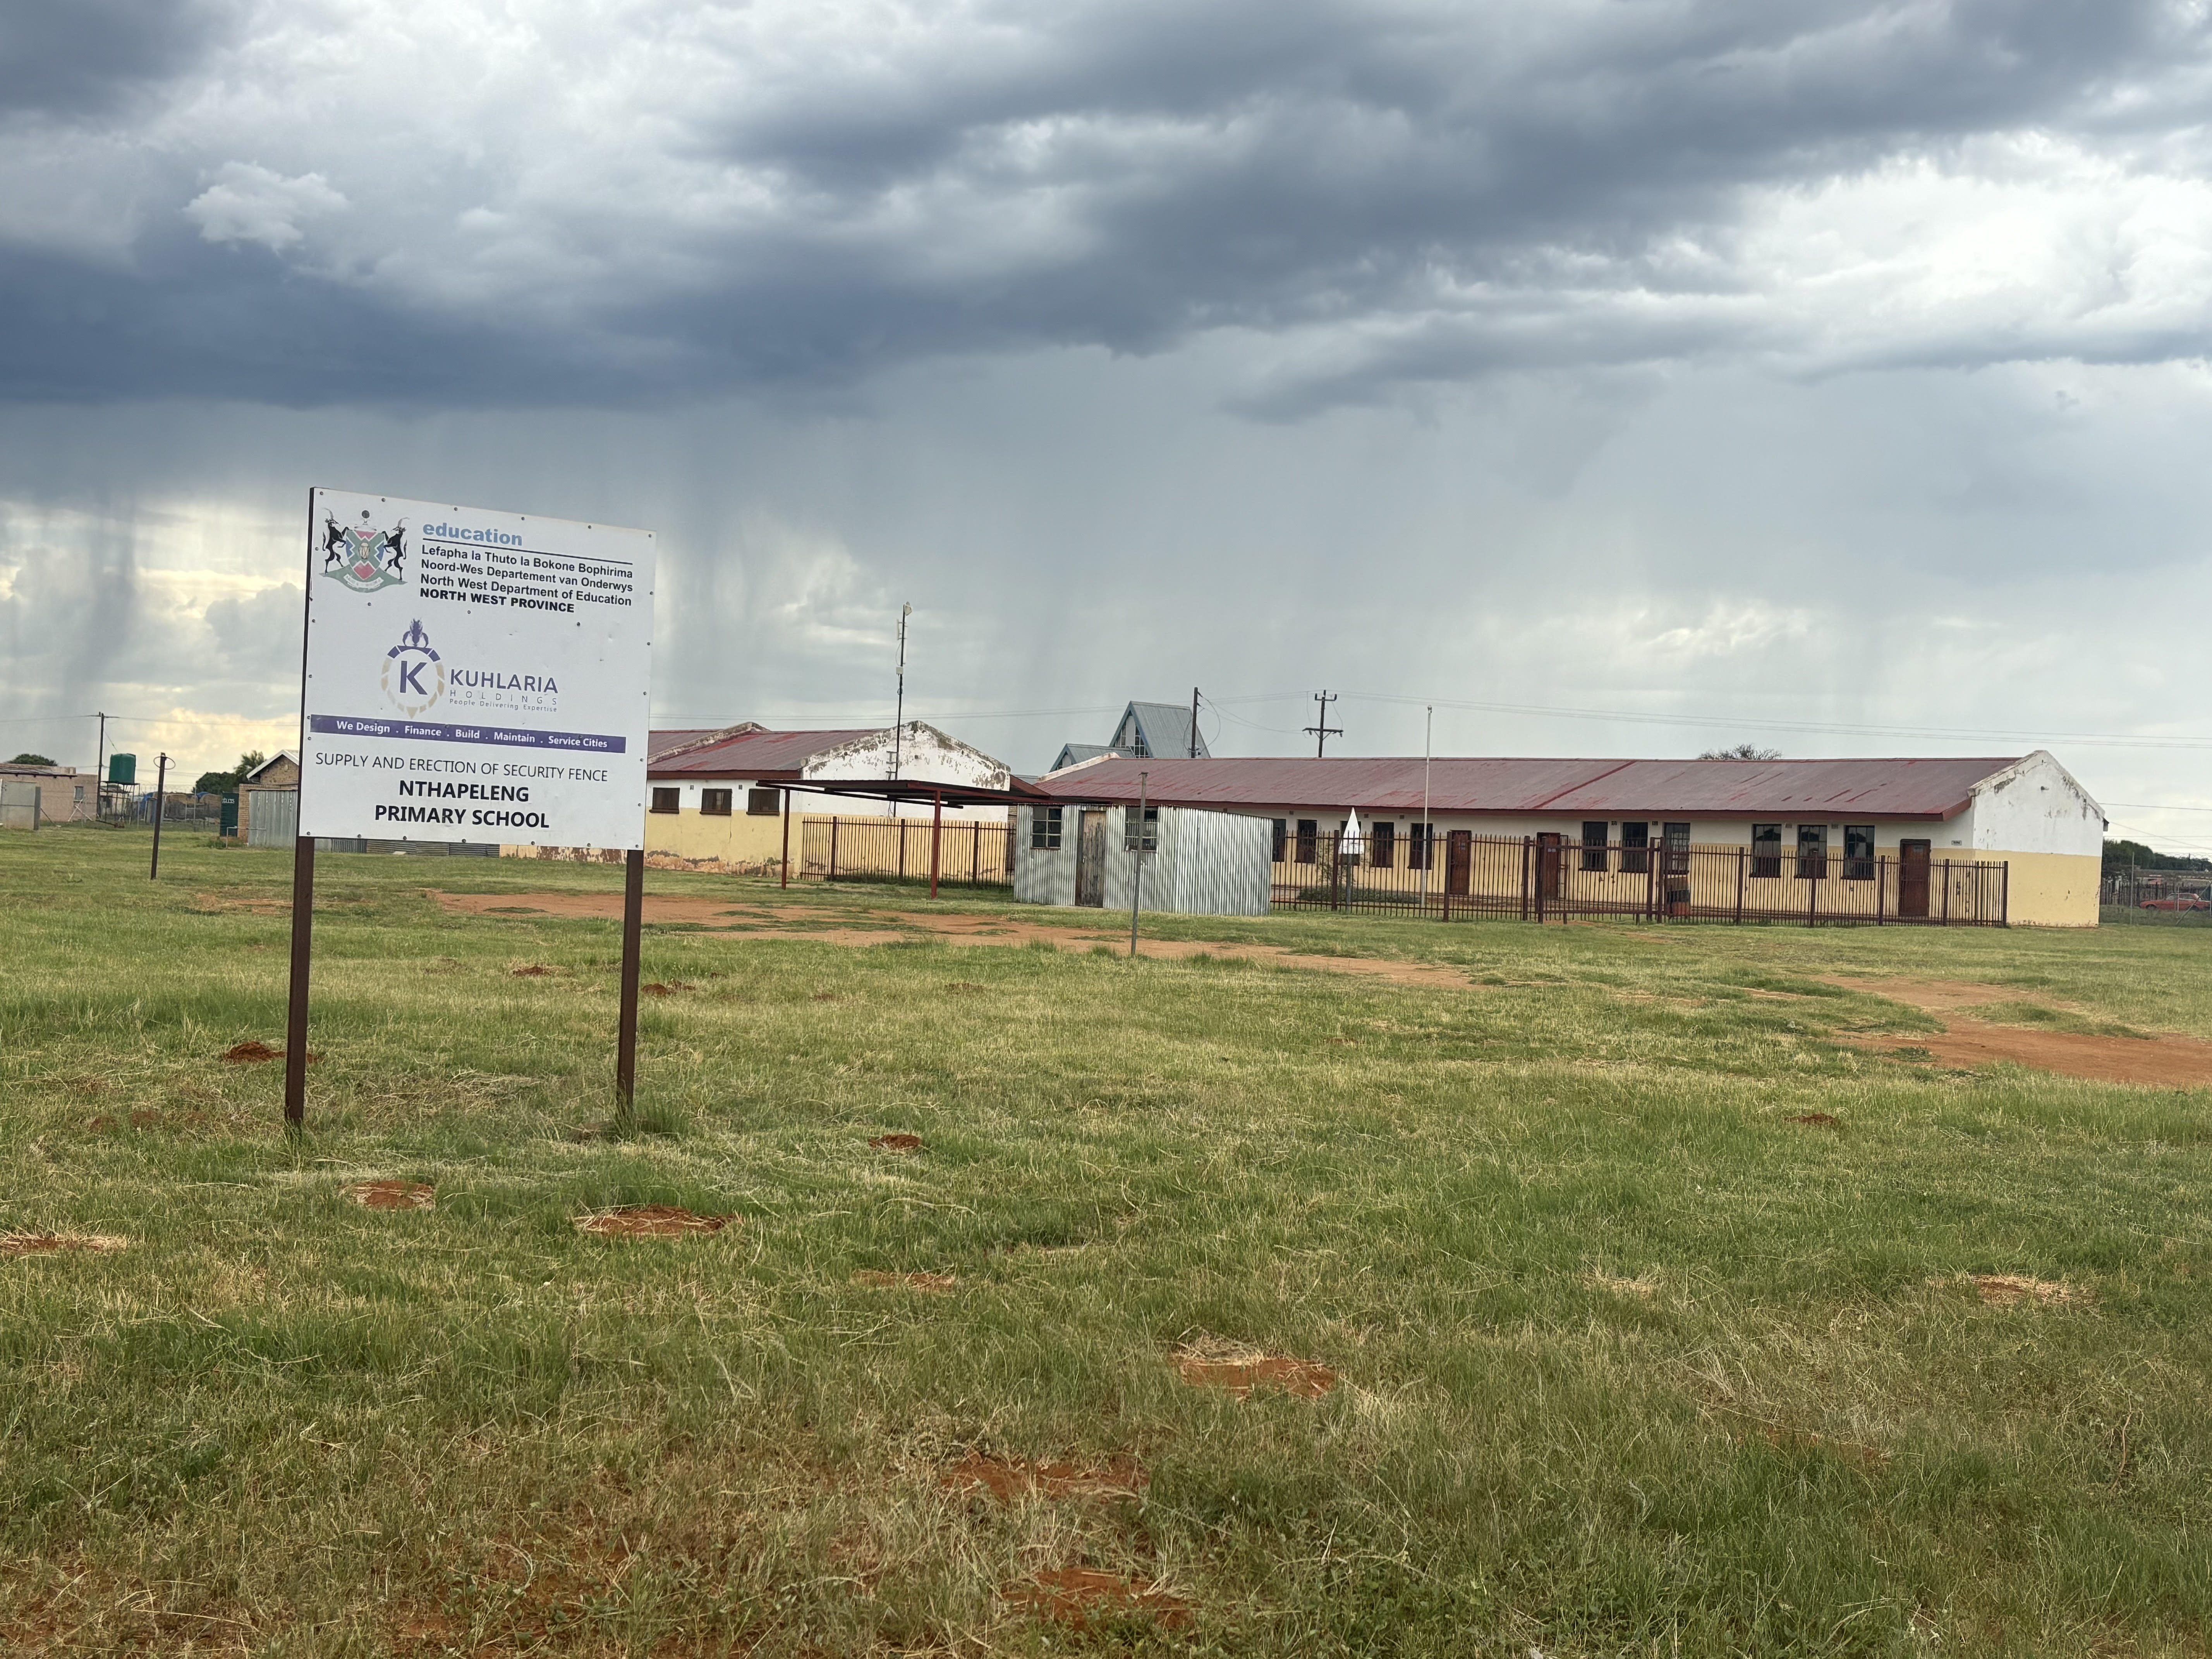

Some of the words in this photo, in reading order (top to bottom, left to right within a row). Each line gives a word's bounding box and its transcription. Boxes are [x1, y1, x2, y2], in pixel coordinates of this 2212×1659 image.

[423, 523, 522, 546] education
[422, 544, 467, 559] Lefapha
[485, 552, 517, 564] Thuto
[534, 558, 575, 571] Bokone
[579, 563, 633, 578] Bophirima
[421, 559, 483, 574] Noord-Wes
[487, 566, 556, 583] Departement
[559, 577, 577, 585] van
[581, 577, 633, 593] Onderwys
[420, 588, 466, 601] NORTH
[471, 593, 507, 605] WEST
[511, 598, 574, 613] PROVINCE
[421, 574, 453, 587] North
[458, 577, 487, 590] West
[491, 581, 558, 598] Department
[562, 590, 573, 599] of
[576, 591, 631, 606] Education
[400, 661, 428, 695] K
[450, 669, 558, 694] KUHLARIA
[480, 701, 518, 710] Delivering
[337, 721, 353, 730] We
[356, 722, 390, 734] Design
[405, 725, 441, 736] Finance
[455, 729, 480, 738] Build
[494, 732, 535, 742] Maintain
[548, 736, 580, 745] Service
[583, 738, 607, 747] Cities
[316, 752, 368, 767] SUPPLY
[372, 756, 404, 769] AND
[410, 758, 476, 773] ERECTION
[481, 763, 498, 775] OF
[503, 764, 564, 778] SECURITY
[569, 769, 608, 781] FENCE
[400, 780, 529, 802] NTHAPELENG
[375, 805, 466, 824] PRIMARY
[472, 810, 549, 828] SCHOOL
